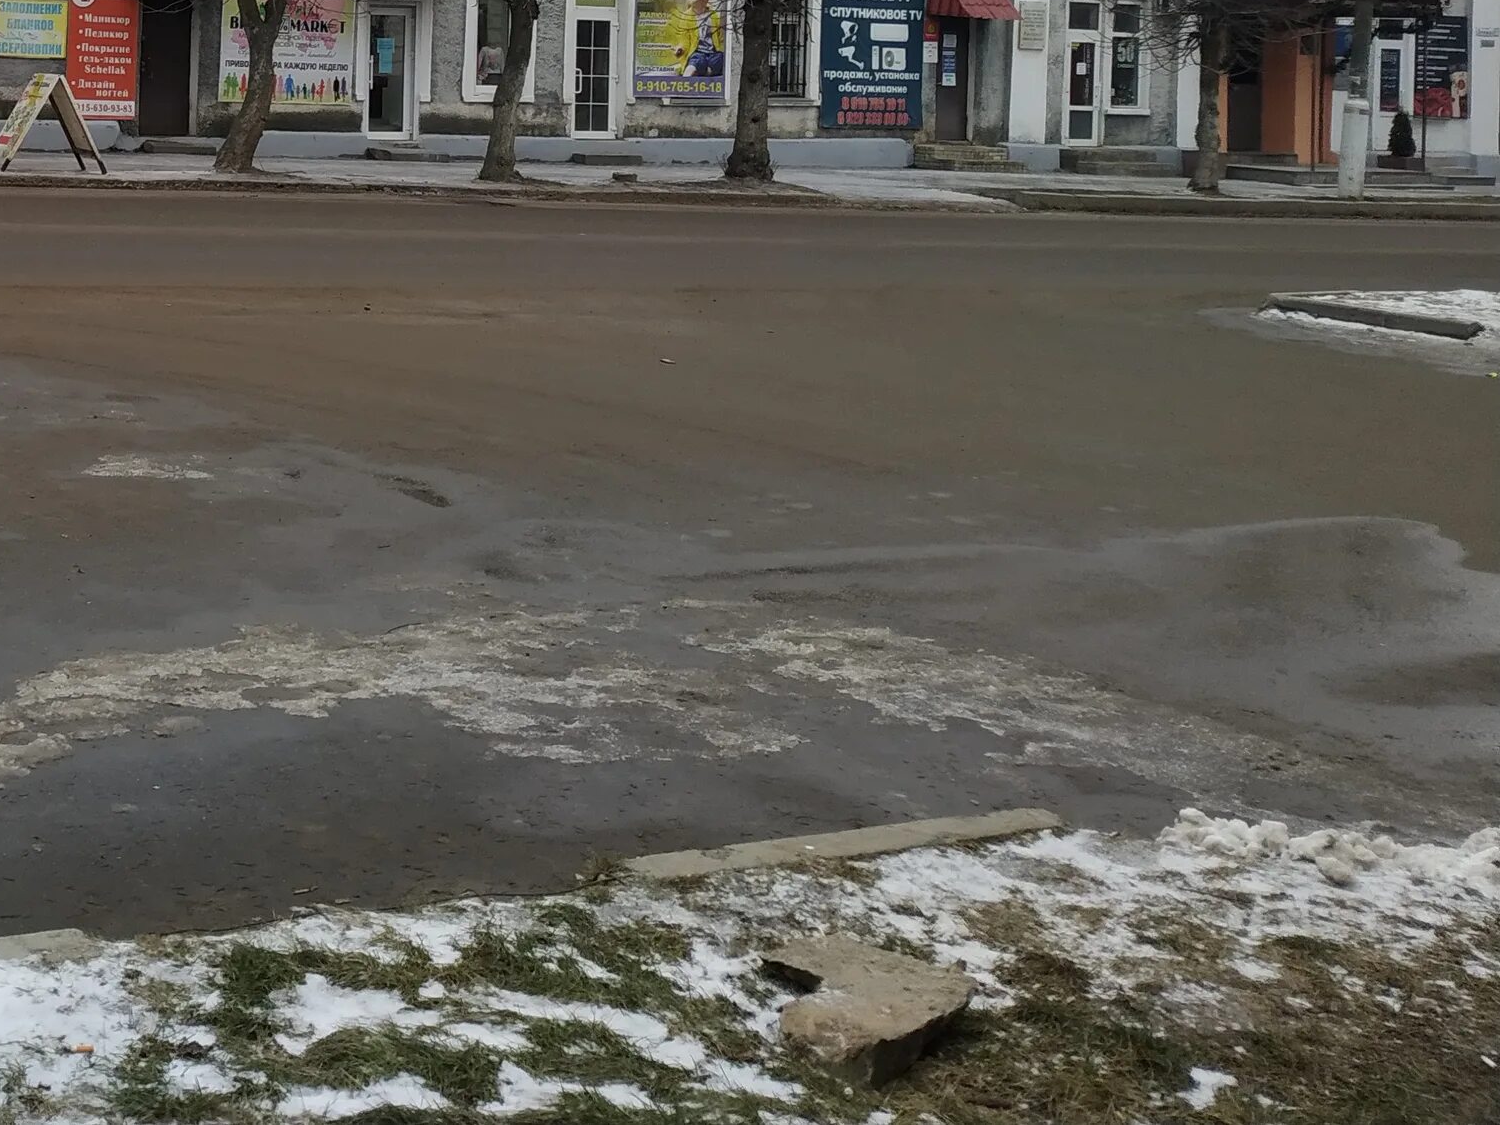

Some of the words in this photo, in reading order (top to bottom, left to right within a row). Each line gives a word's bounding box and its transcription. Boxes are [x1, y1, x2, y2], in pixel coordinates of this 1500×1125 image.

[0, 1, 63, 15] ЗАПОЛНЕНИЕ
[829, 6, 907, 21] СПУТНИКОВОЕ
[909, 10, 923, 21] TV
[7, 18, 54, 31] БЛАНКОВ
[84, 13, 131, 26] Маникюр
[84, 28, 129, 40] Педикюр
[81, 42, 131, 54] Покрытие
[79, 55, 132, 65] гель-лаком
[225, 59, 250, 68] ПРИВО
[284, 61, 317, 71] КАЖДУЮ
[319, 62, 349, 72] НЕДЕЛЮ
[84, 64, 126, 75] Schellak
[824, 70, 873, 81] продажа,
[874, 71, 920, 81] установка
[78, 79, 115, 89] Дизайн
[636, 80, 722, 93] 8-910-765-16-18
[838, 82, 908, 95] обслуживание
[96, 89, 129, 98] ногтей
